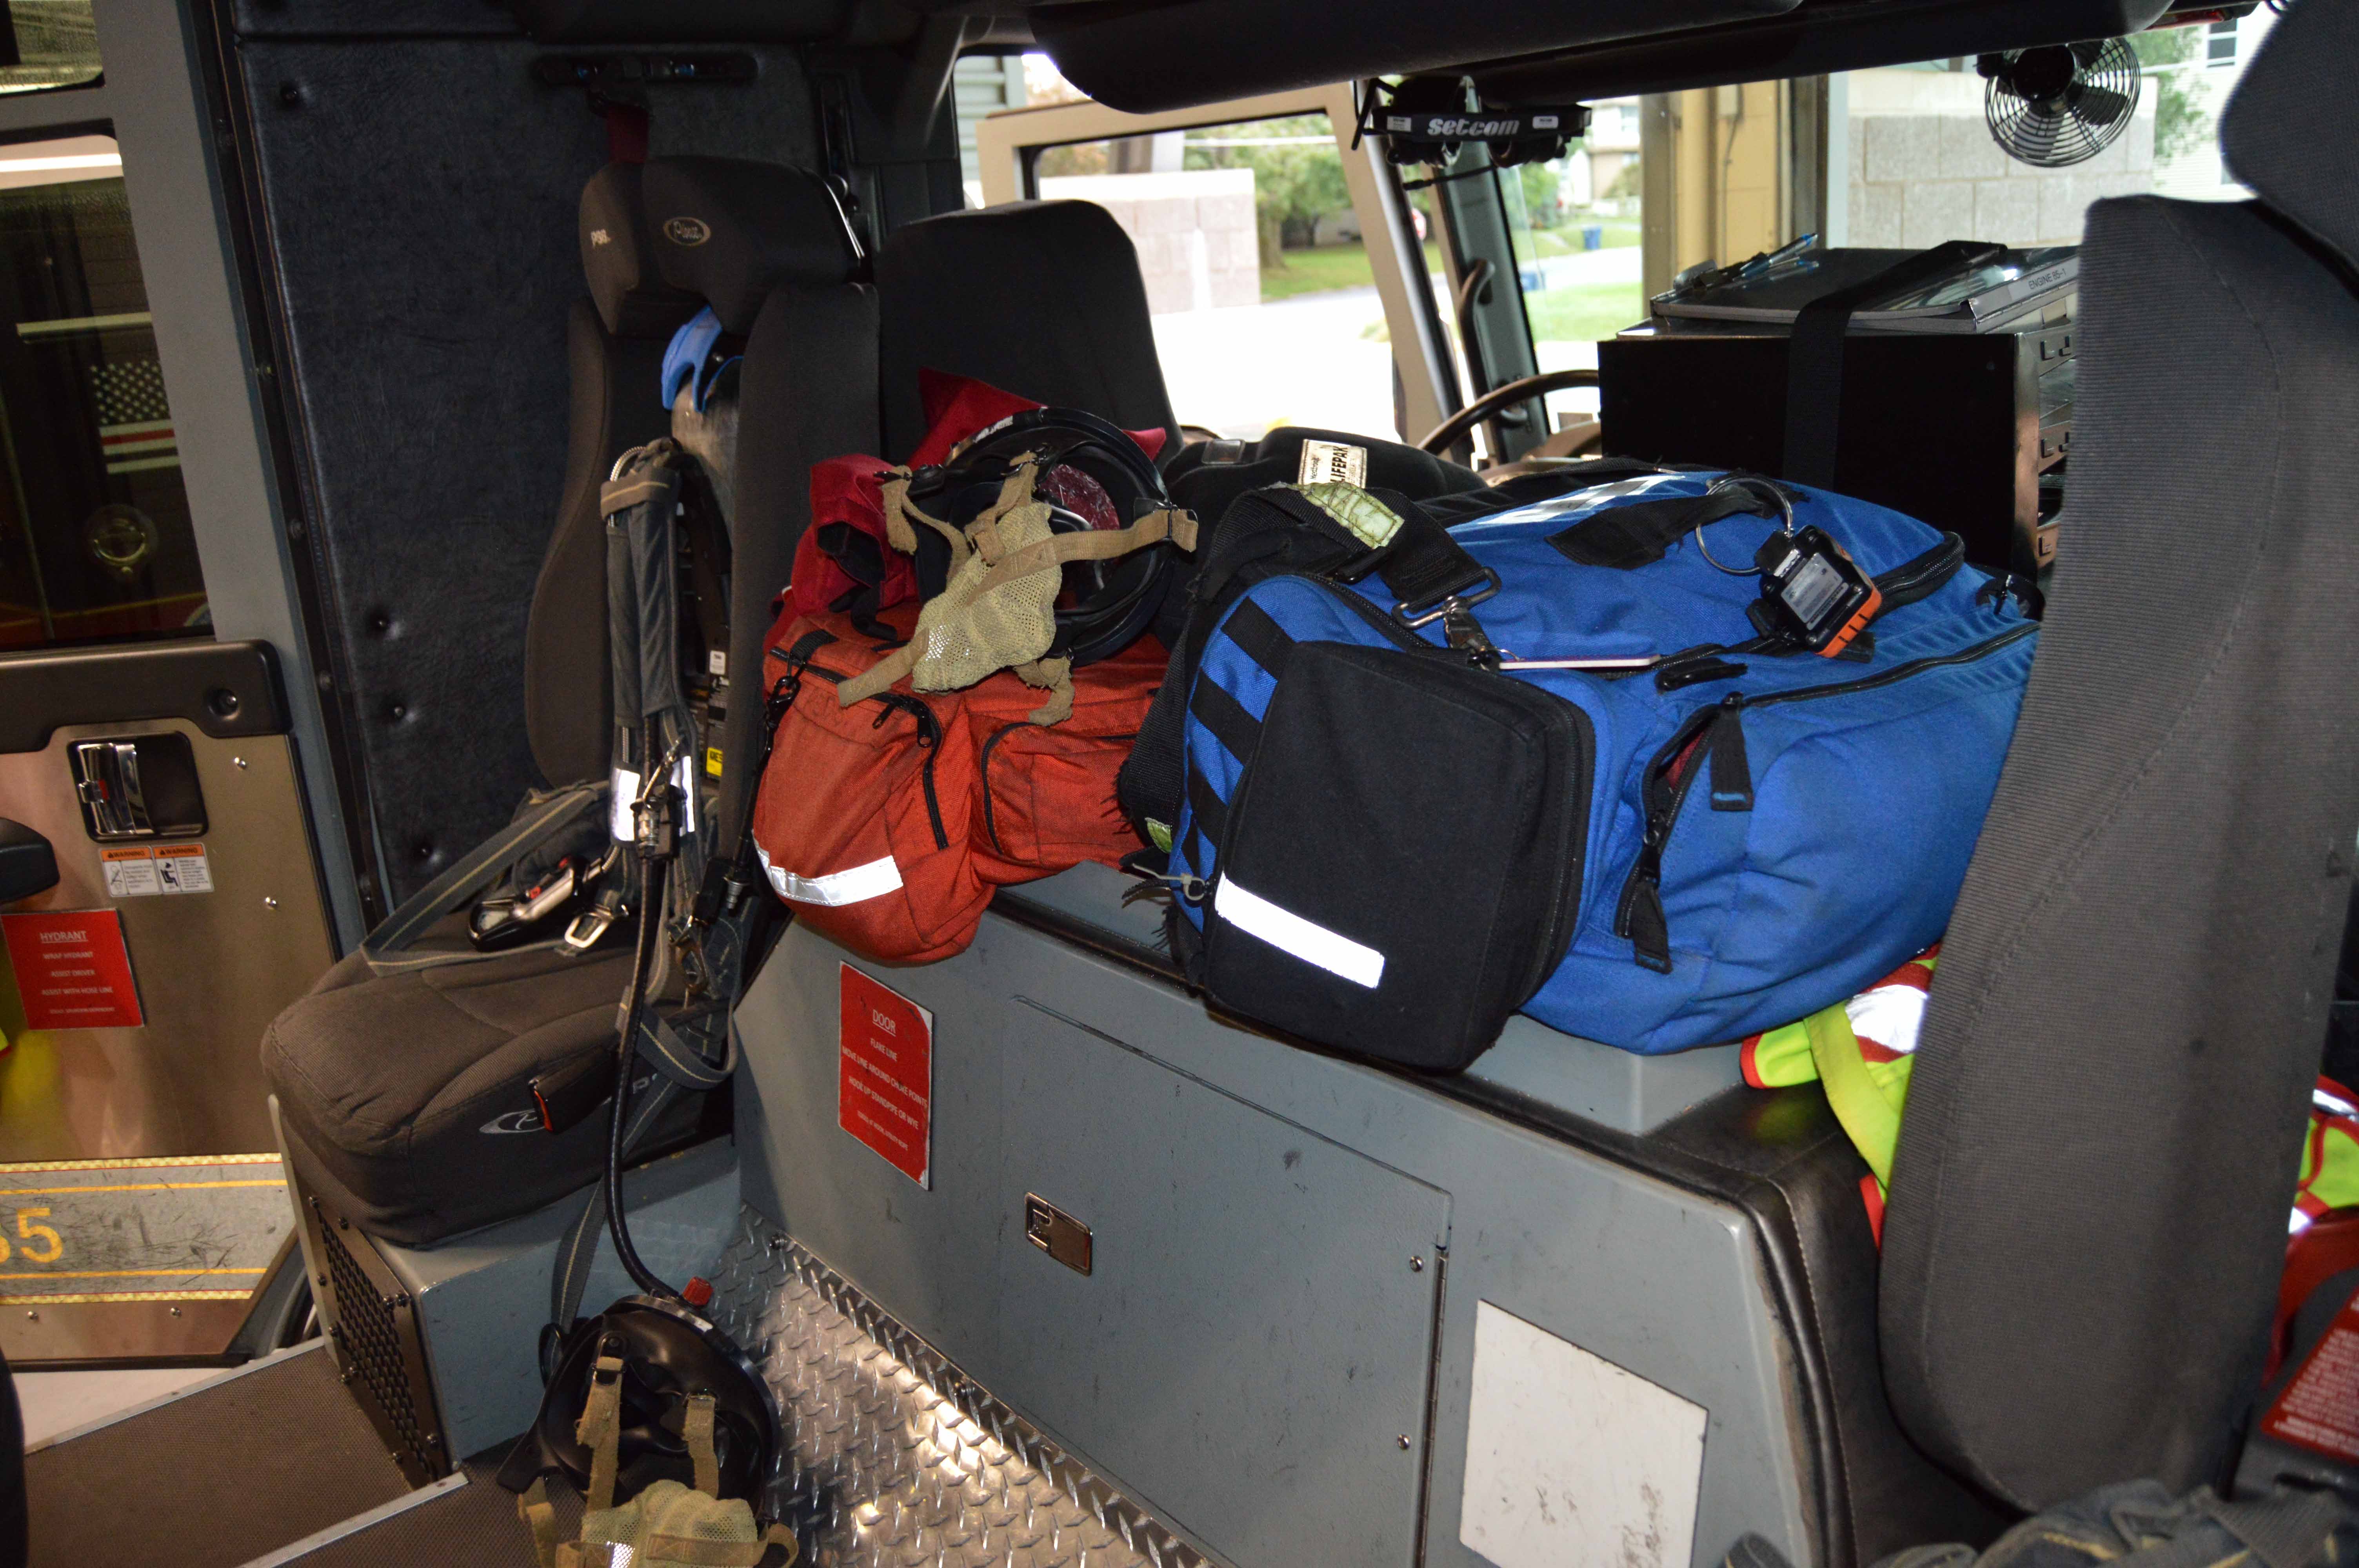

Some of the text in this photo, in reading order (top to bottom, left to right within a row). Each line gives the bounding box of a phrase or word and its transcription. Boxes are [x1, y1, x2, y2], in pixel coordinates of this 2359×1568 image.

[1427, 118, 1520, 136] setcom
[2028, 273, 2053, 289] ENGINE
[1330, 446, 1349, 483] LIFEPAK
[40, 931, 87, 942] HYDRANT
[873, 1009, 896, 1034] DOOR
[909, 1089, 927, 1109] POINTS
[0, 1207, 63, 1263] 5
